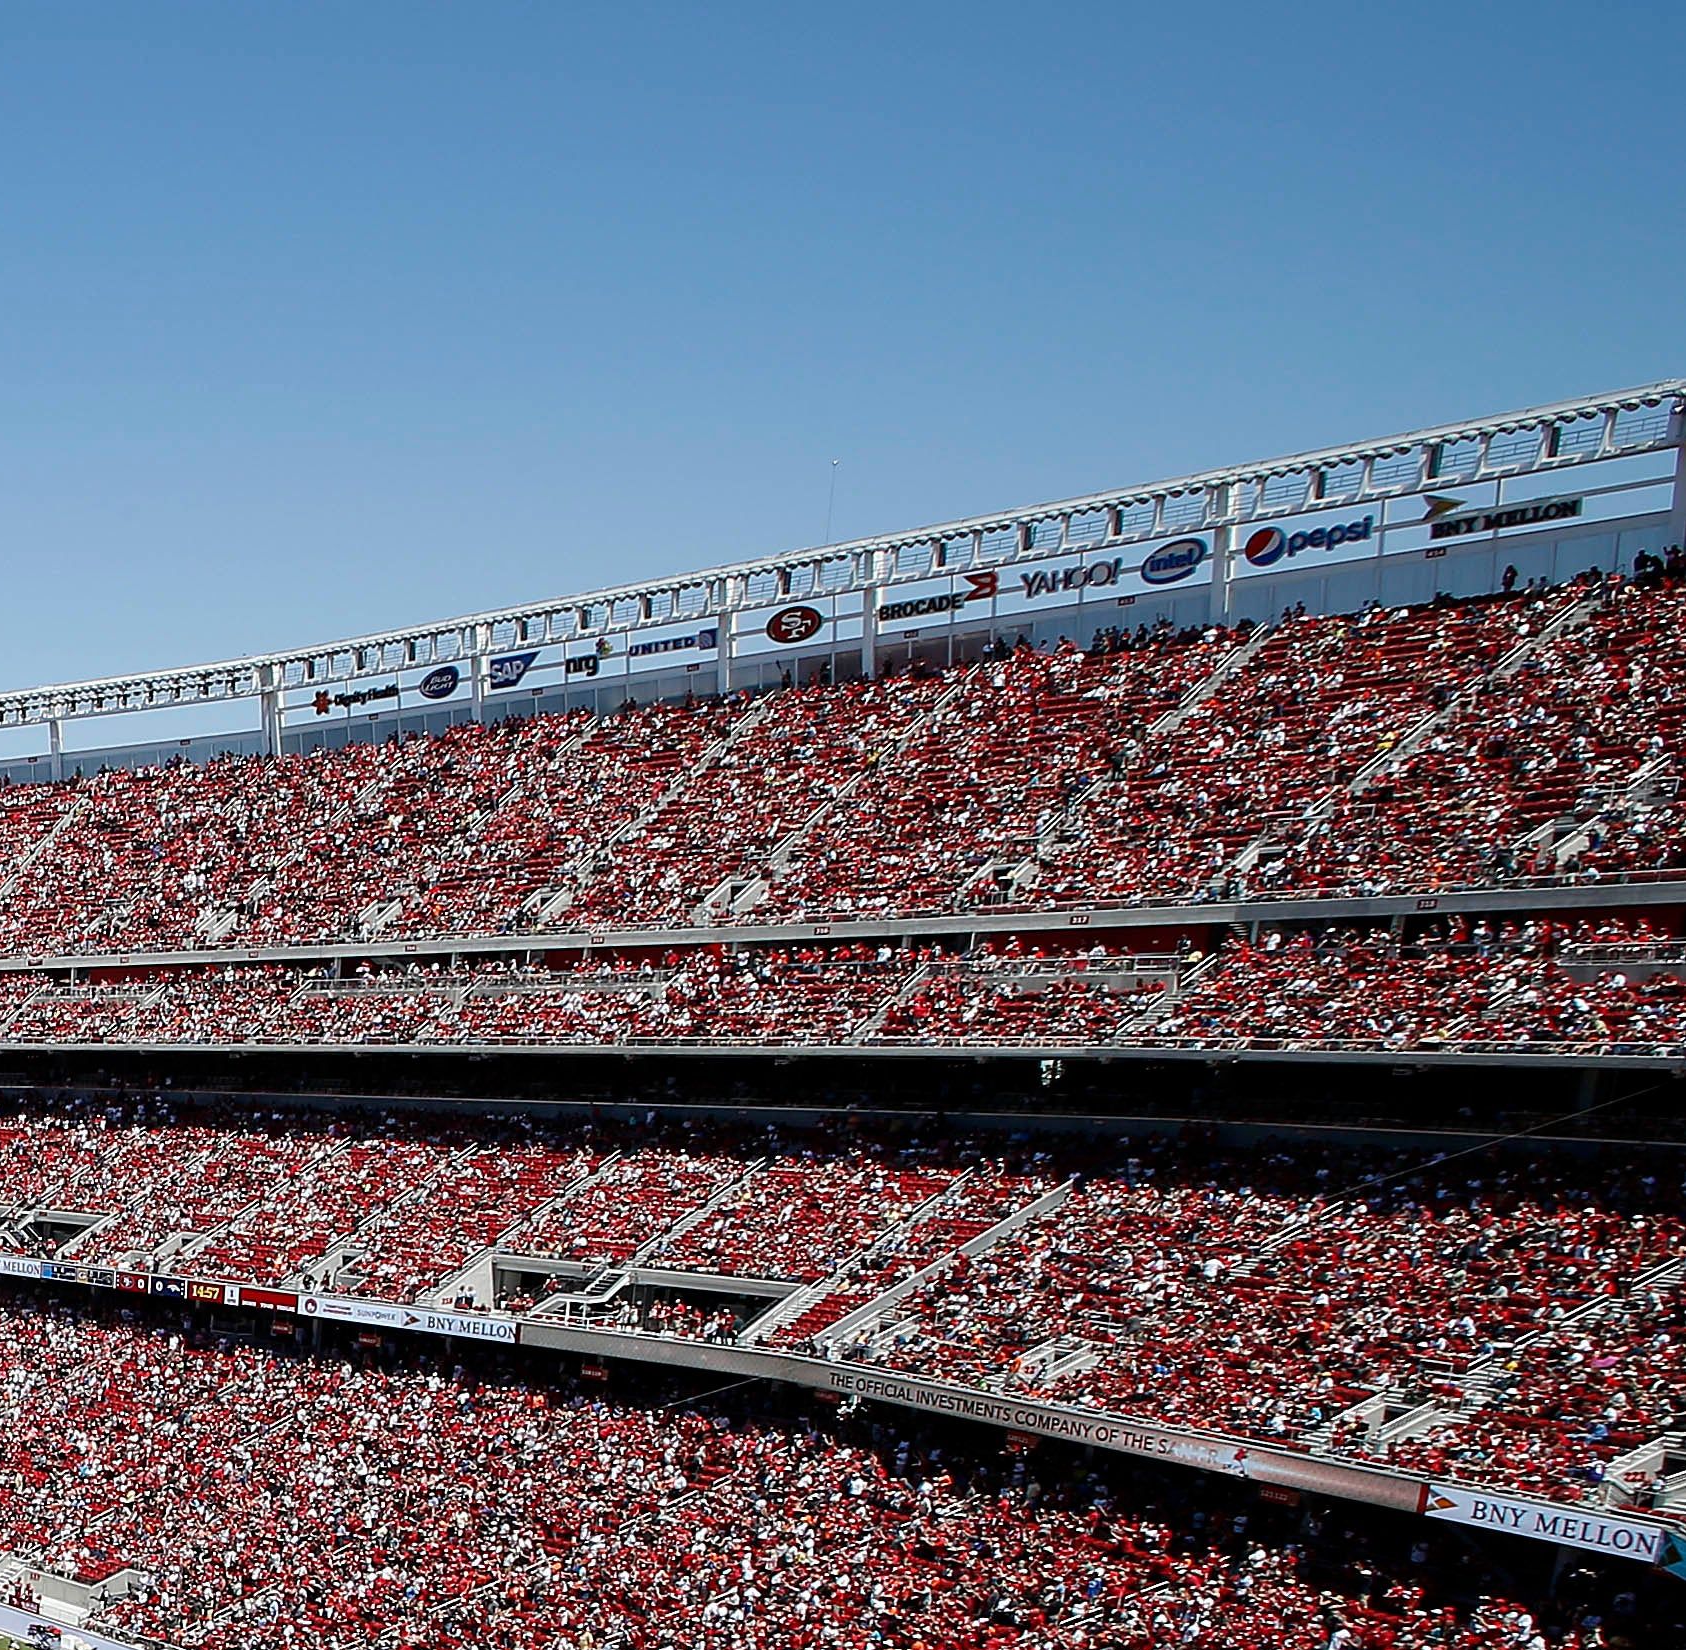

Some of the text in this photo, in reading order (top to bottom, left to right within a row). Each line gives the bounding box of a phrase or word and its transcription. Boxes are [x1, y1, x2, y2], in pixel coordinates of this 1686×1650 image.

[1431, 500, 1579, 540] BNY MELLON
[1287, 515, 1373, 558] pepsi
[1149, 547, 1196, 573] intel
[1021, 557, 1124, 598] YAHOO!
[879, 592, 965, 621] BROCADE
[629, 637, 696, 656] UNITED
[491, 660, 524, 684] SAP
[566, 654, 598, 677] nrg
[427, 680, 453, 691] LIGHT
[430, 673, 452, 684] BUD
[4, 1260, 40, 1275] MELLON
[156, 1281, 163, 1291] 0
[192, 1285, 219, 1299] 14:57
[427, 1316, 517, 1339] BNY MELLON
[829, 1371, 1153, 1453] THE OFFICIAL INVESTMENTS COMPANY OF THE
[1470, 1499, 1658, 1555] BNY MELLON
